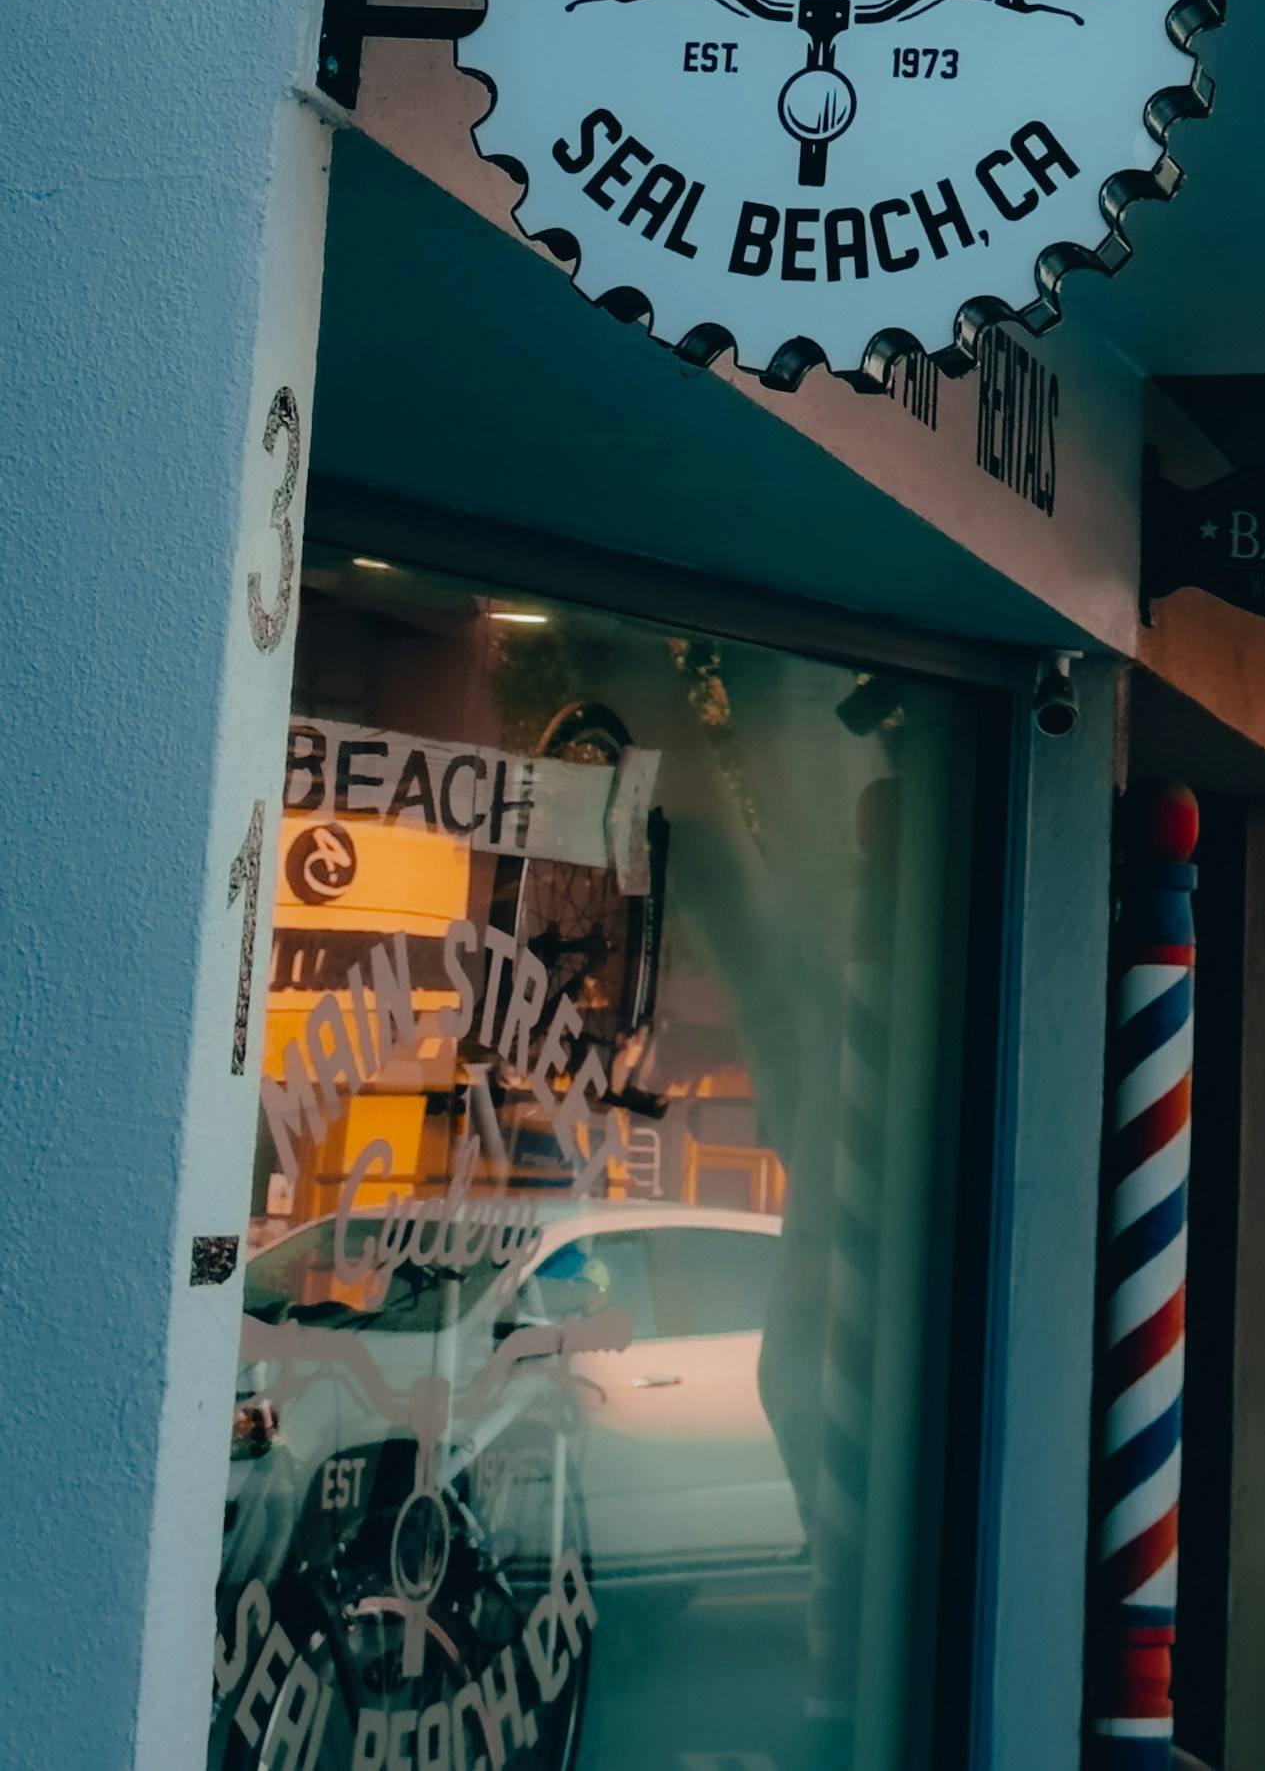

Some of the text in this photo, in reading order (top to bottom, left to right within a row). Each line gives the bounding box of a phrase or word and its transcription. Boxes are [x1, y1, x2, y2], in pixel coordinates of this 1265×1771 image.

[683, 43, 959, 80] EST. 1973
[552, 108, 1081, 282] SEAL BEACH, CA
[283, 724, 535, 849] BEACH
[260, 931, 416, 1183] MAIN
[438, 920, 625, 1200] STREET
[334, 1137, 542, 1312] Cyclery
[321, 1458, 366, 1510] EST
